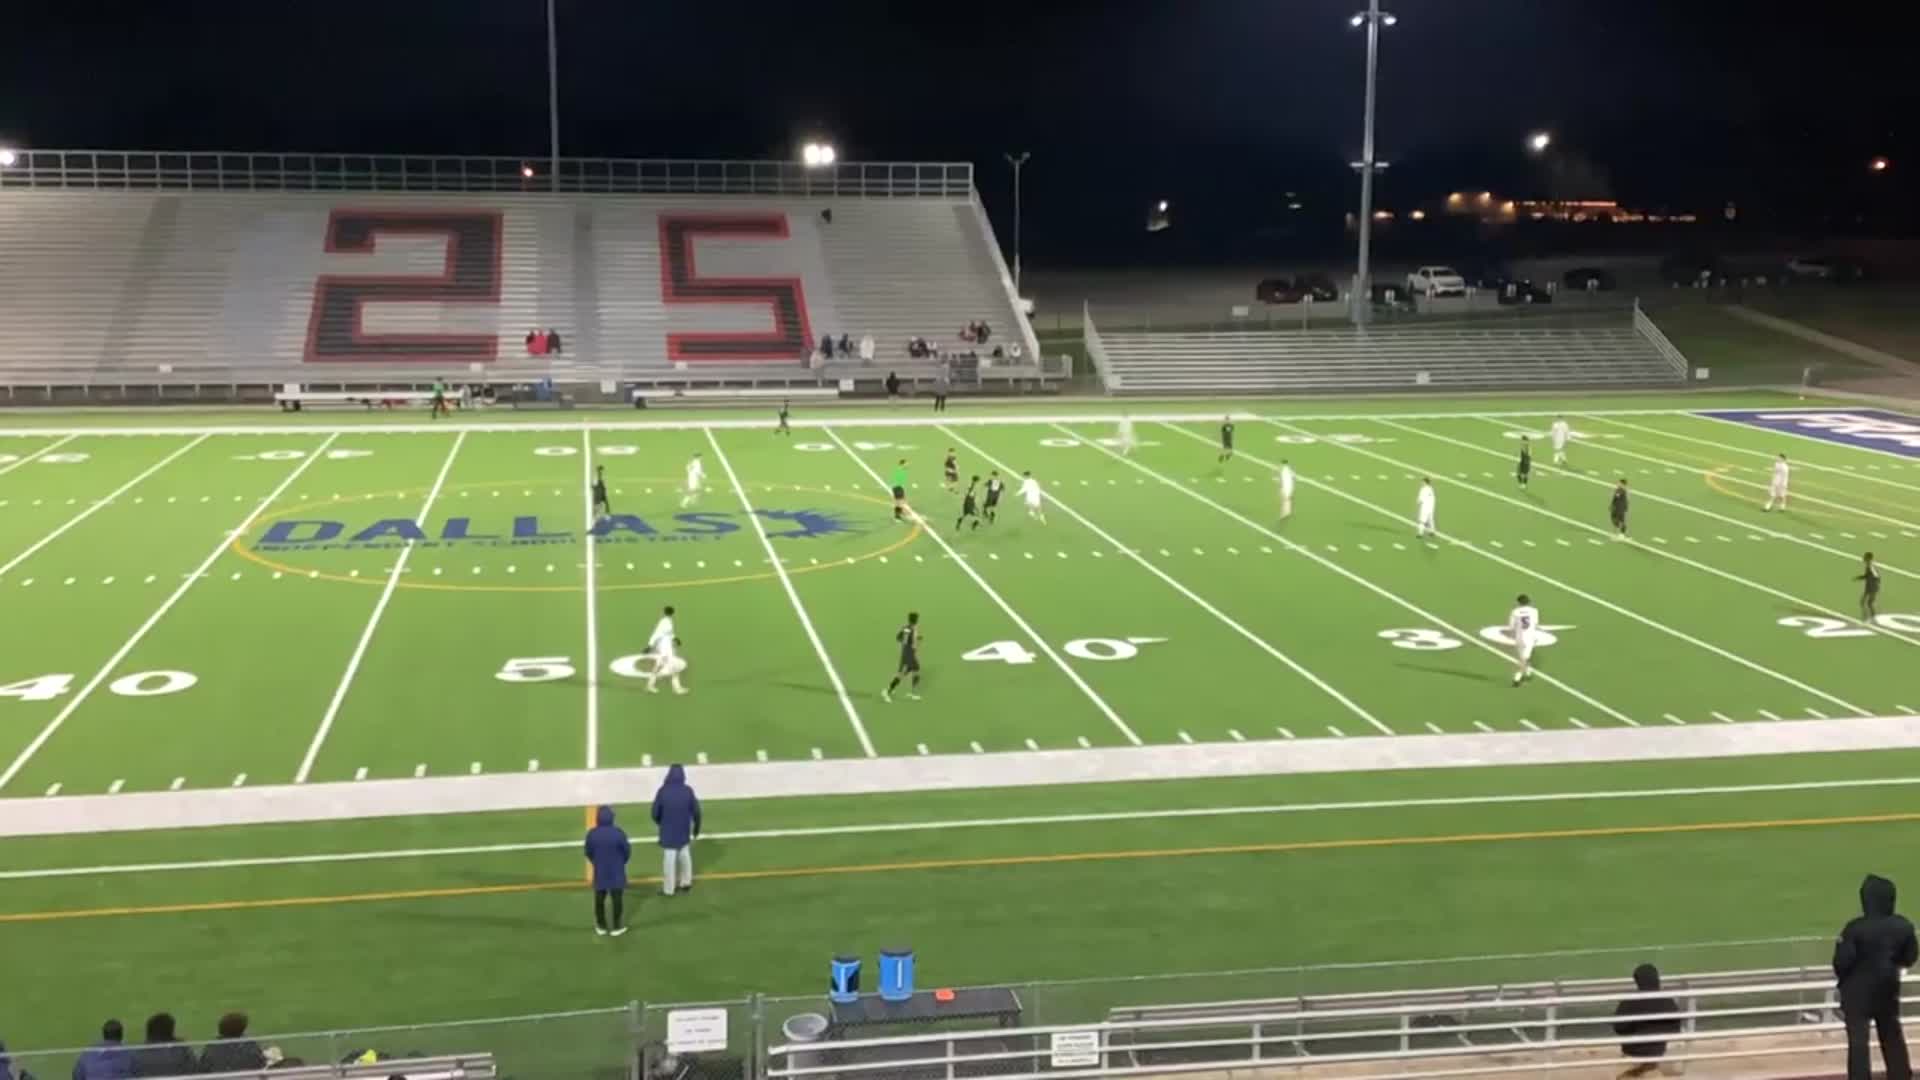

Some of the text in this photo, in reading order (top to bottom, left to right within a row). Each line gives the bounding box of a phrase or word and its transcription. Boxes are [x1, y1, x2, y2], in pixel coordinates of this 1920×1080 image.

[258, 512, 740, 543] DALLAS
[961, 637, 1138, 664] 40
[495, 652, 687, 682] 50
[0, 669, 198, 700] 40
